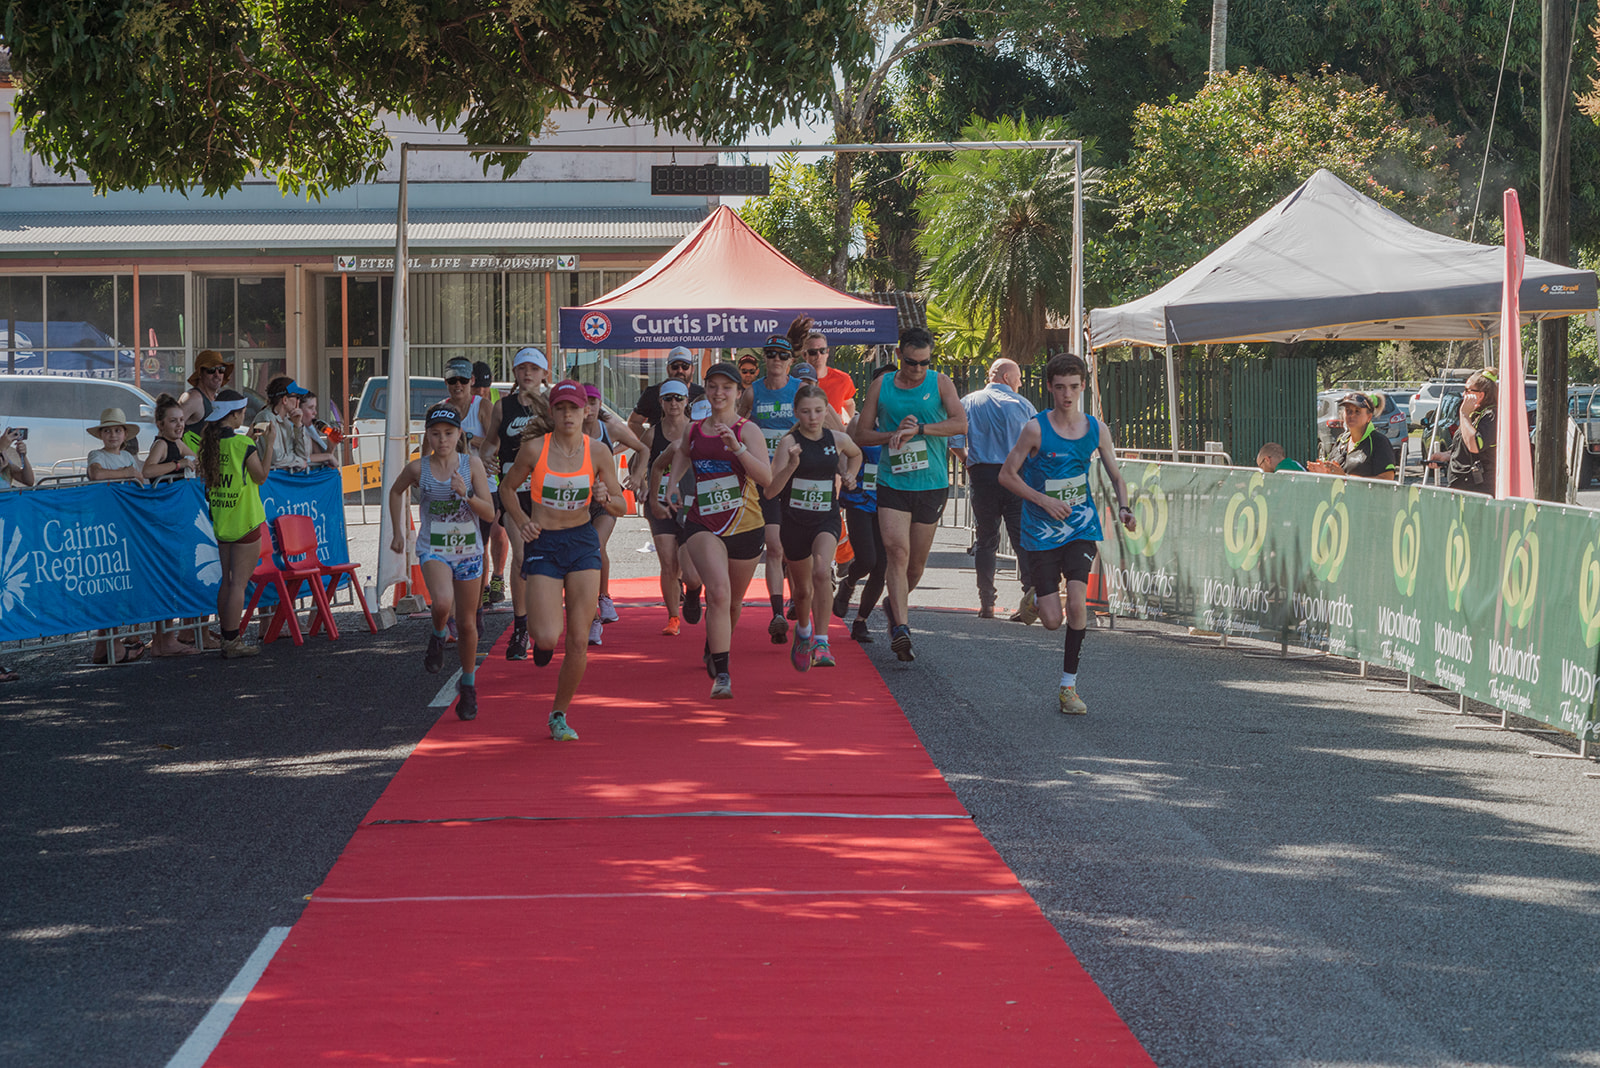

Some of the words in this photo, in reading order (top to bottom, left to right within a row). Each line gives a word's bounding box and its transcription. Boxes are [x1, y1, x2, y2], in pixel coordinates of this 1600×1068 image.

[360, 258, 421, 268] ETERAL
[431, 258, 461, 268] LIFE
[470, 258, 555, 269] FELLOWSHIP
[632, 313, 702, 334] Curtis
[707, 313, 749, 334] Pitt
[754, 320, 779, 332] MP
[899, 452, 919, 464] 161
[554, 489, 579, 501] 167
[707, 489, 731, 504] 166
[802, 491, 824, 502] 165
[1057, 487, 1079, 501] 152
[43, 519, 118, 553] Cairns
[442, 534, 467, 547] 162
[31, 537, 132, 592] Regional
[78, 575, 133, 597] COUNCIL
[1105, 562, 1174, 598] Woolworths
[1203, 577, 1269, 614] Woolworths
[1292, 590, 1354, 629] Woolworths
